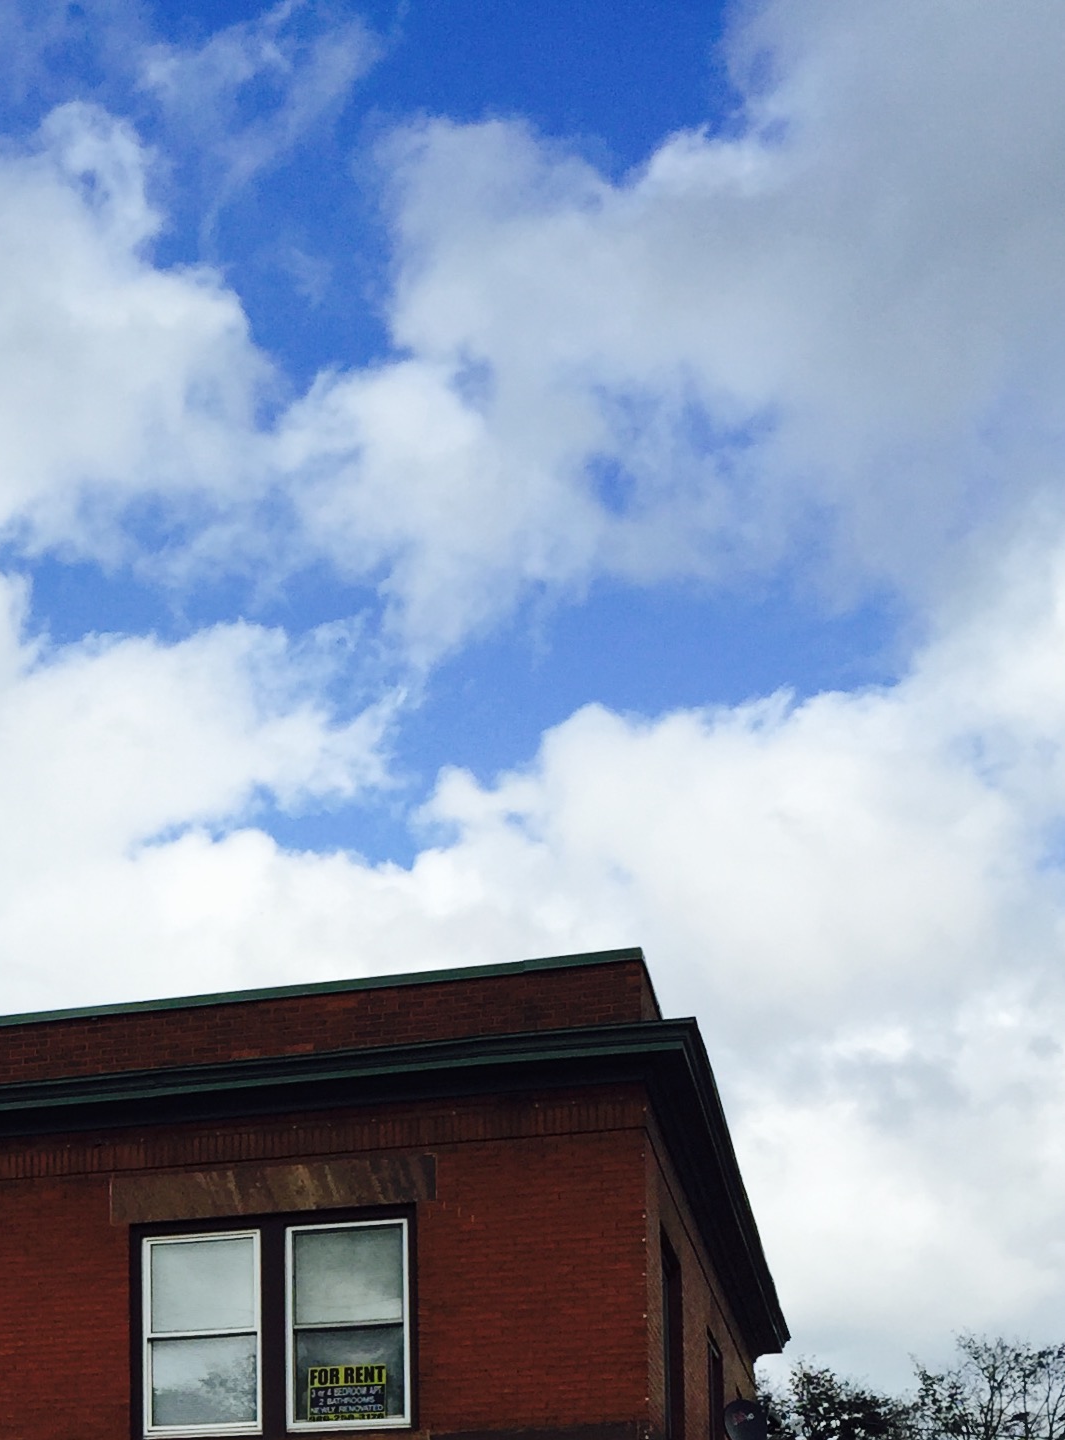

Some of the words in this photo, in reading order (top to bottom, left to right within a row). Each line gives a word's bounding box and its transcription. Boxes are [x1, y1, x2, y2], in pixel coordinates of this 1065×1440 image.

[310, 1368, 339, 1386] FOR
[344, 1366, 386, 1384] RENT
[334, 1387, 367, 1397] BEDROOM
[318, 1398, 324, 1406] 2
[326, 1396, 375, 1405] BATHROOMS
[310, 1406, 336, 1414] NEWLY
[338, 1404, 384, 1412] RENOVATED
